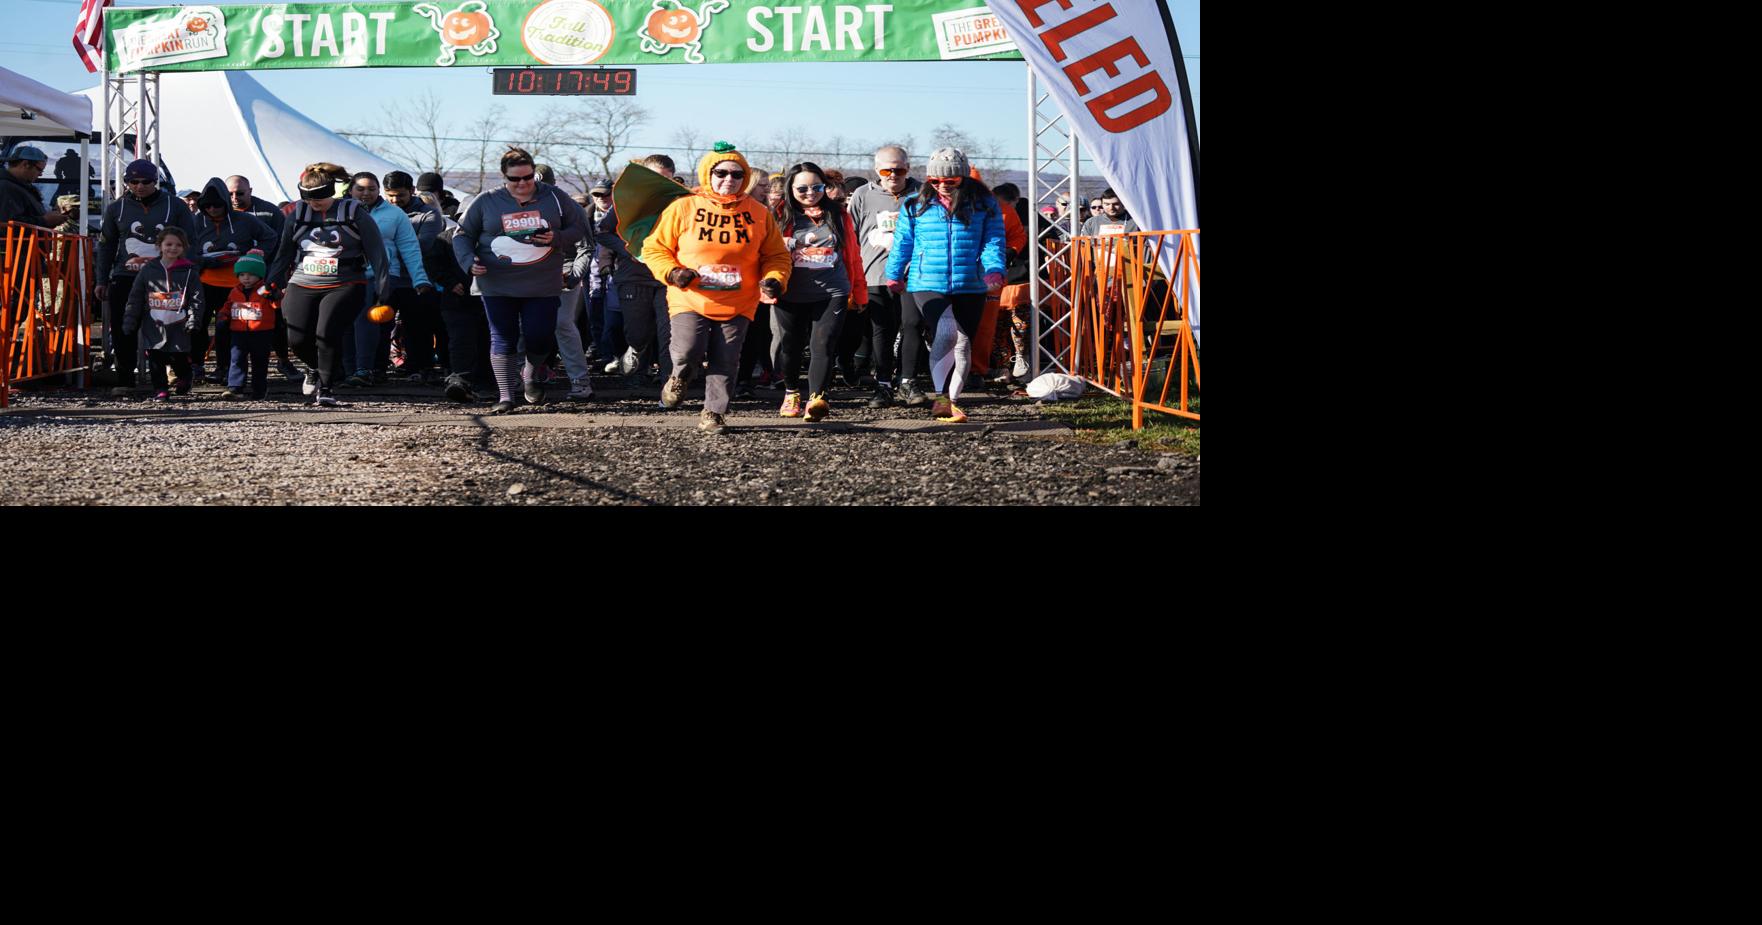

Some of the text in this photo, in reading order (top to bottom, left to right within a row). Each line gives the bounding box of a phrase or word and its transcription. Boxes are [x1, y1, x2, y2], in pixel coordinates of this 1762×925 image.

[746, 4, 893, 52] START
[952, 16, 1002, 33] THE GRE
[185, 36, 209, 49] RUN
[261, 12, 396, 59] START
[527, 26, 603, 52] Tradition
[506, 71, 631, 93] 10:17:49
[504, 216, 540, 229] 29901
[694, 208, 756, 229] SUPER
[698, 227, 751, 245] MOM
